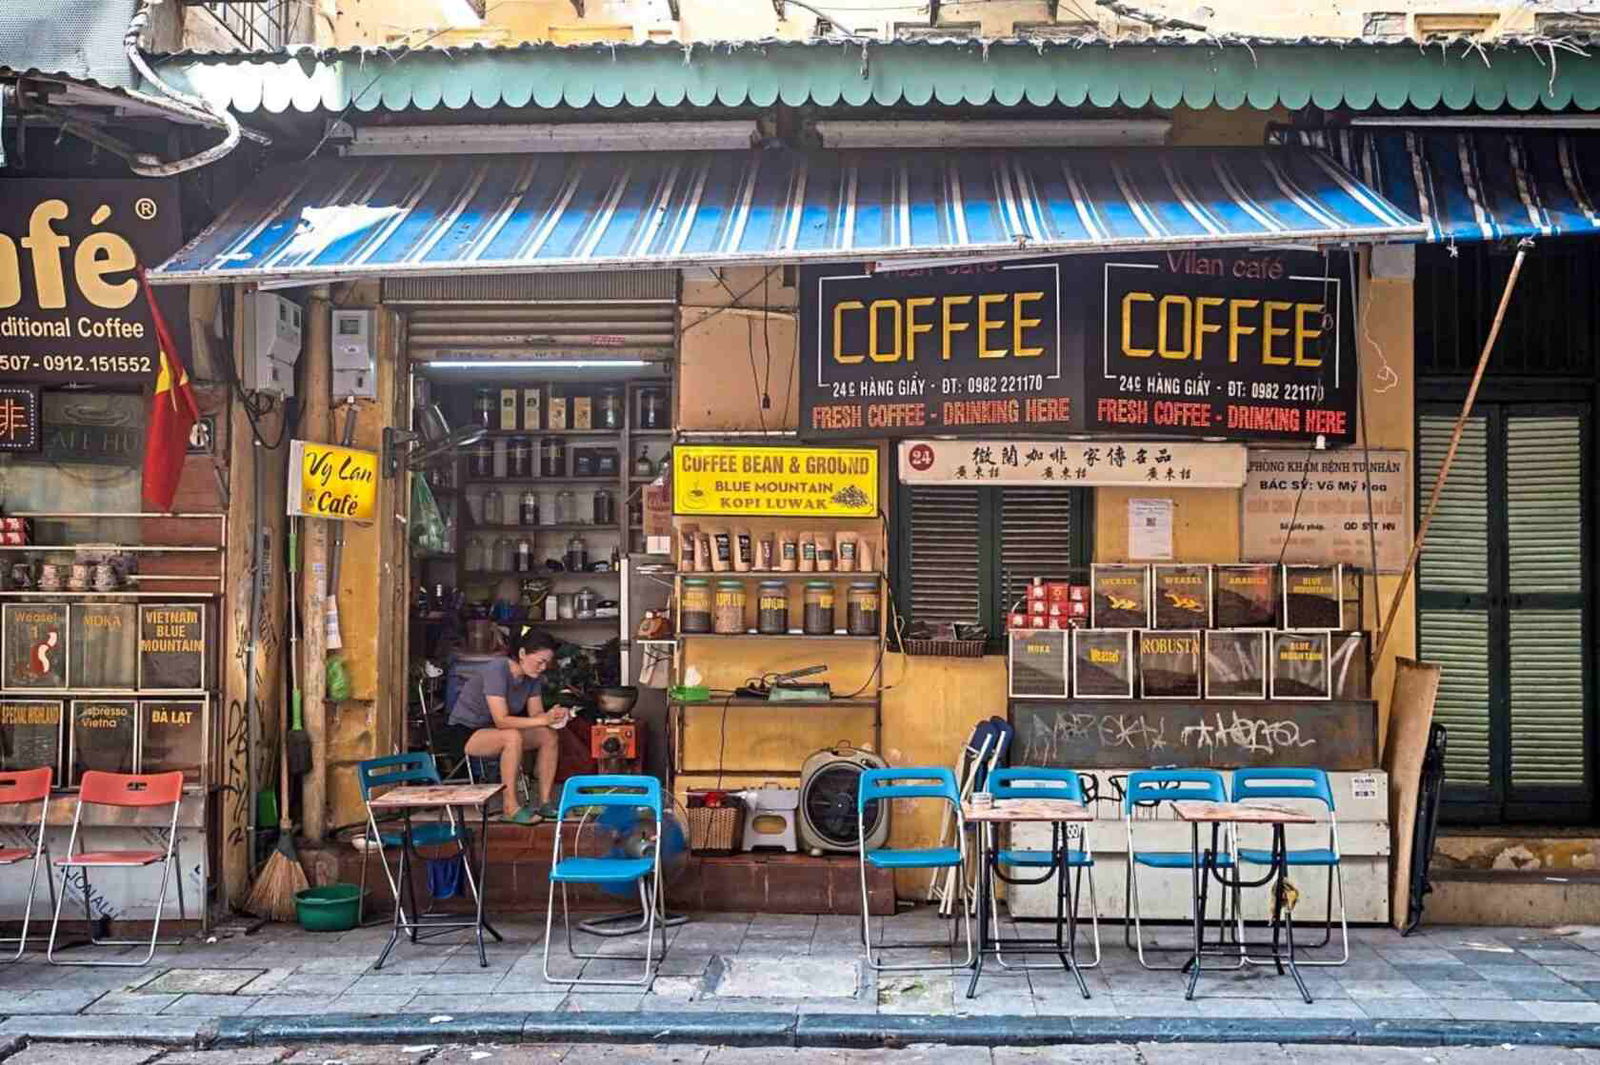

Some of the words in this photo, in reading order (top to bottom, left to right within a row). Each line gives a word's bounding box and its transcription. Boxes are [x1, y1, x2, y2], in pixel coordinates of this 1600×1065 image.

[1232, 256, 1283, 279] café
[78, 317, 144, 338] Coffee
[833, 291, 1044, 364] COFFEE
[1121, 291, 1325, 367] COFFEE
[43, 355, 151, 372] 0912.151552
[860, 376, 894, 397] HÀNG
[968, 376, 998, 394] 0982
[1001, 374, 1043, 393] 221170
[1252, 382, 1279, 400] 0982
[1284, 383, 1325, 402] 221170
[812, 405, 862, 430] FRESH
[868, 402, 926, 428] COFFEE
[943, 399, 1019, 426] DRINKING
[1025, 397, 1071, 424] HERE
[1097, 398, 1148, 424] FRESH
[1154, 401, 1211, 428] COFFEE
[1228, 404, 1300, 432] DRINKING
[1305, 409, 1347, 434] HERE
[682, 454, 737, 473] COFFEE
[742, 456, 784, 474] BEAN
[789, 457, 801, 474] &
[806, 456, 870, 475] GROUND
[911, 450, 932, 465] 24
[306, 452, 333, 486] Vy
[338, 455, 373, 484] Lan
[715, 480, 751, 492] BLUE
[755, 482, 833, 494] MOUNTAIN
[1259, 478, 1288, 491] BÁC
[317, 491, 358, 516] Café
[720, 497, 764, 509] KOPI
[767, 498, 828, 510] LUWAK
[83, 615, 123, 627] MOKA
[146, 611, 198, 624] VIETNAM
[156, 625, 187, 638] BLUE
[140, 639, 205, 652] MOUNTAIN
[1142, 639, 1199, 655] ROBUSTA
[171, 711, 193, 727] LẠT
